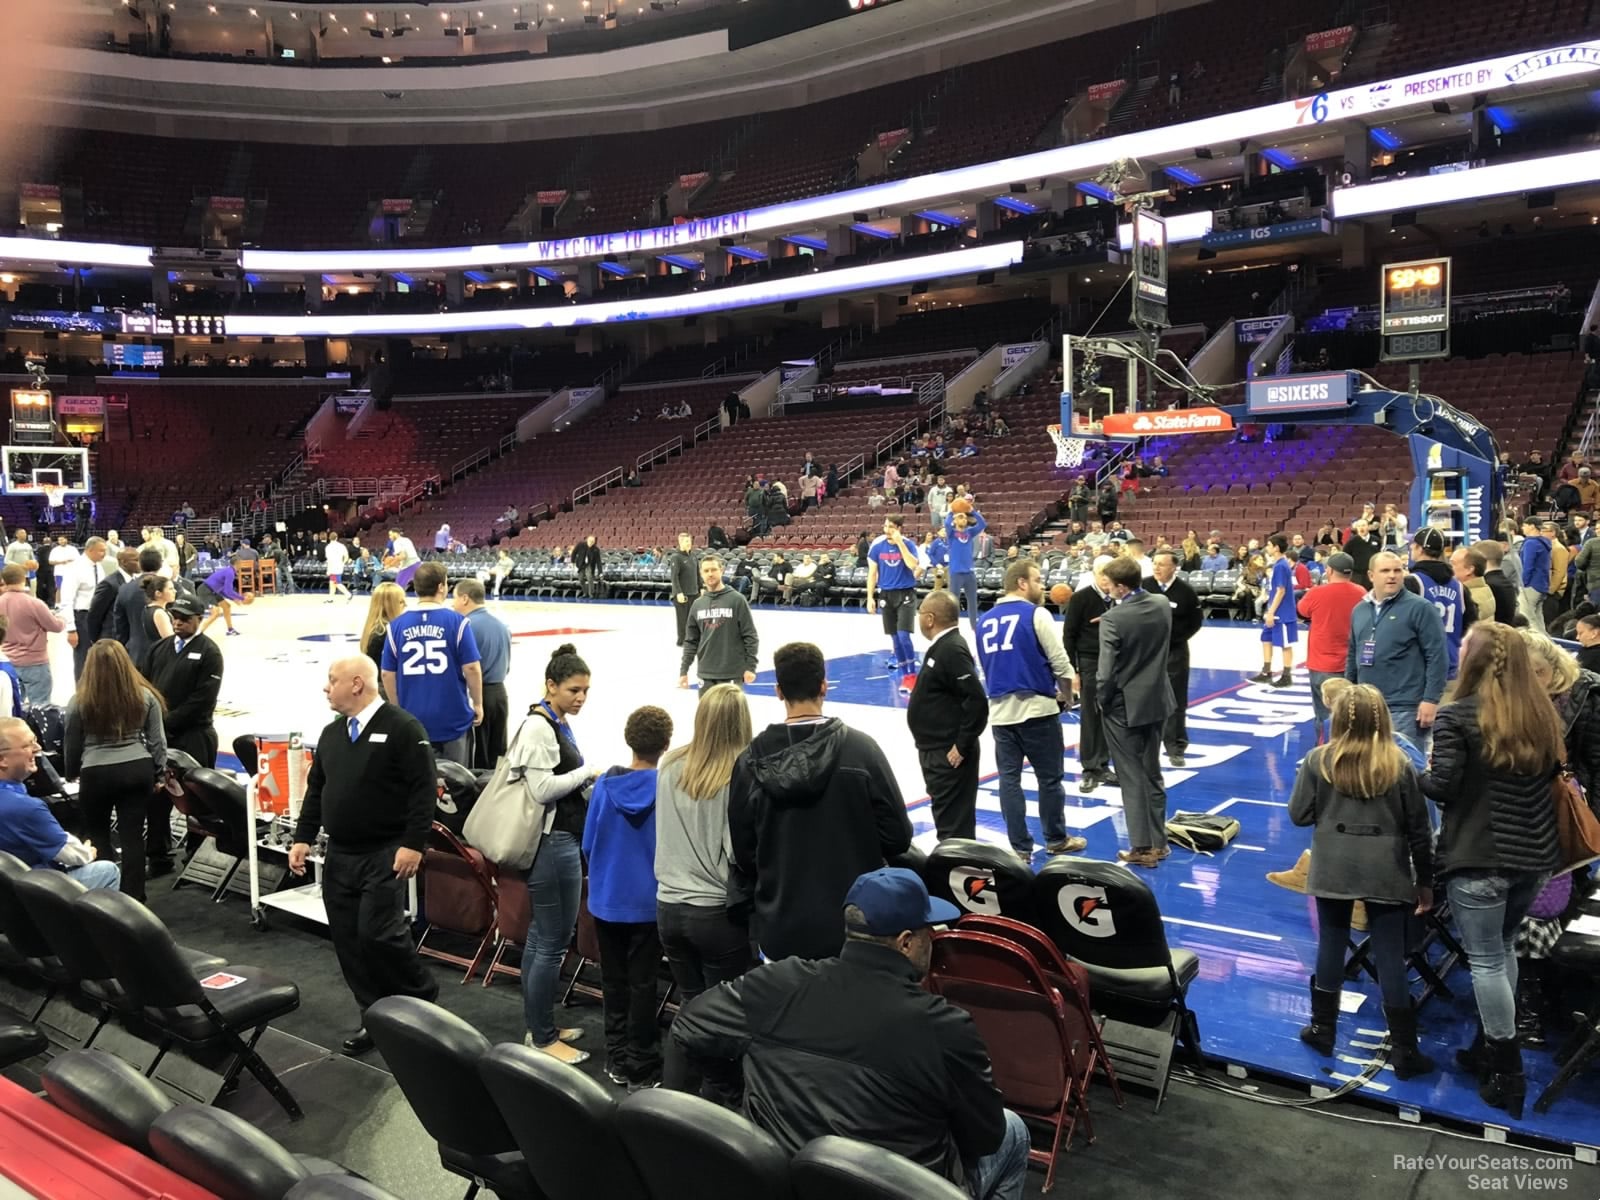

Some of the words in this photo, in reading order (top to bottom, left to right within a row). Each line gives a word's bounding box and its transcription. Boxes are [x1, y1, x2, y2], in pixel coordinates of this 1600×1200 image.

[1294, 92, 1329, 123] 76
[1341, 96, 1355, 109] VS
[1404, 71, 1473, 97] PRESENTED
[1477, 69, 1493, 83] BY
[538, 237, 613, 258] WELCOME
[625, 231, 641, 248] TO
[653, 226, 680, 245] THE
[688, 211, 750, 240] MOMENT
[1250, 227, 1271, 239] IGS
[1242, 319, 1280, 331] GEICO
[1404, 313, 1445, 326] TISSOT
[1267, 382, 1329, 402] @SIXERS
[403, 625, 445, 640] SIMMONS
[982, 613, 1020, 654] 27
[401, 639, 448, 676] 25
[948, 865, 1002, 916] G
[1057, 883, 1117, 938] G
